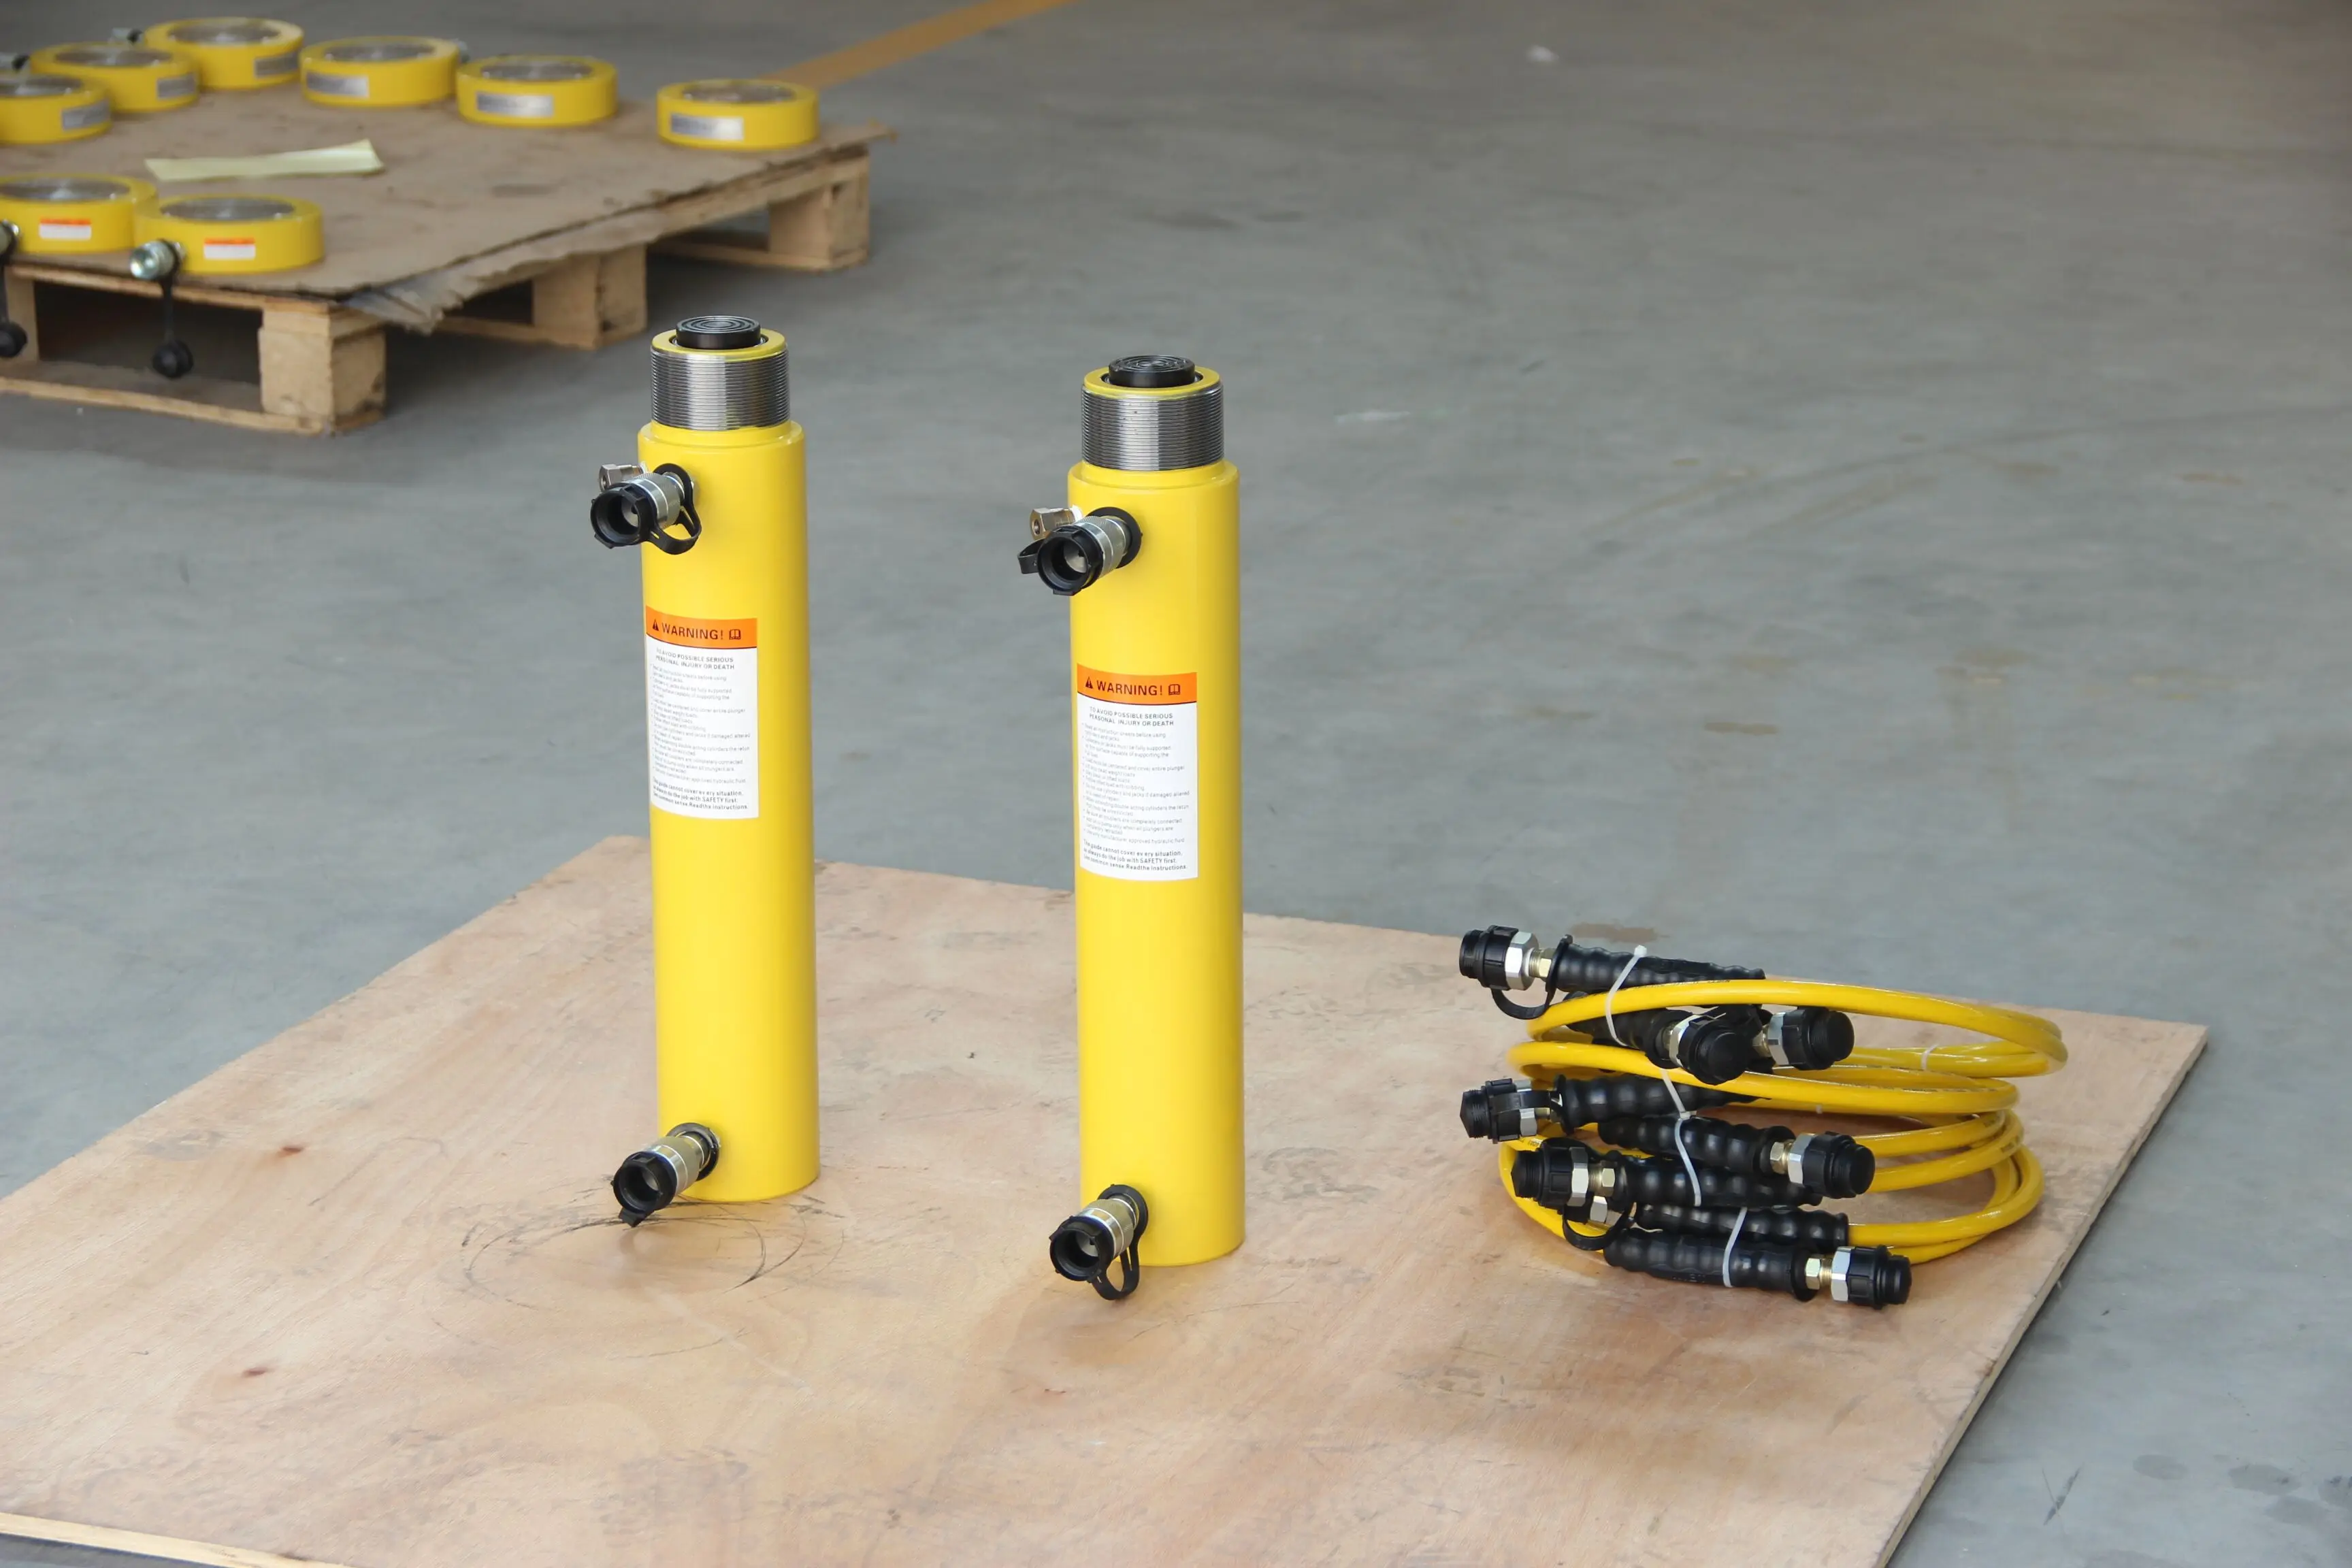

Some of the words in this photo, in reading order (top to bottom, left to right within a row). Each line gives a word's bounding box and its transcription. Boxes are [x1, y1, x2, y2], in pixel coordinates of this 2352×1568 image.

[662, 622, 723, 640] WARNING!
[656, 655, 679, 666] PERSONAL
[678, 653, 704, 662] POSSIBLE
[1096, 680, 1162, 696] WARNING!
[1090, 713, 1115, 723] PERSONAL
